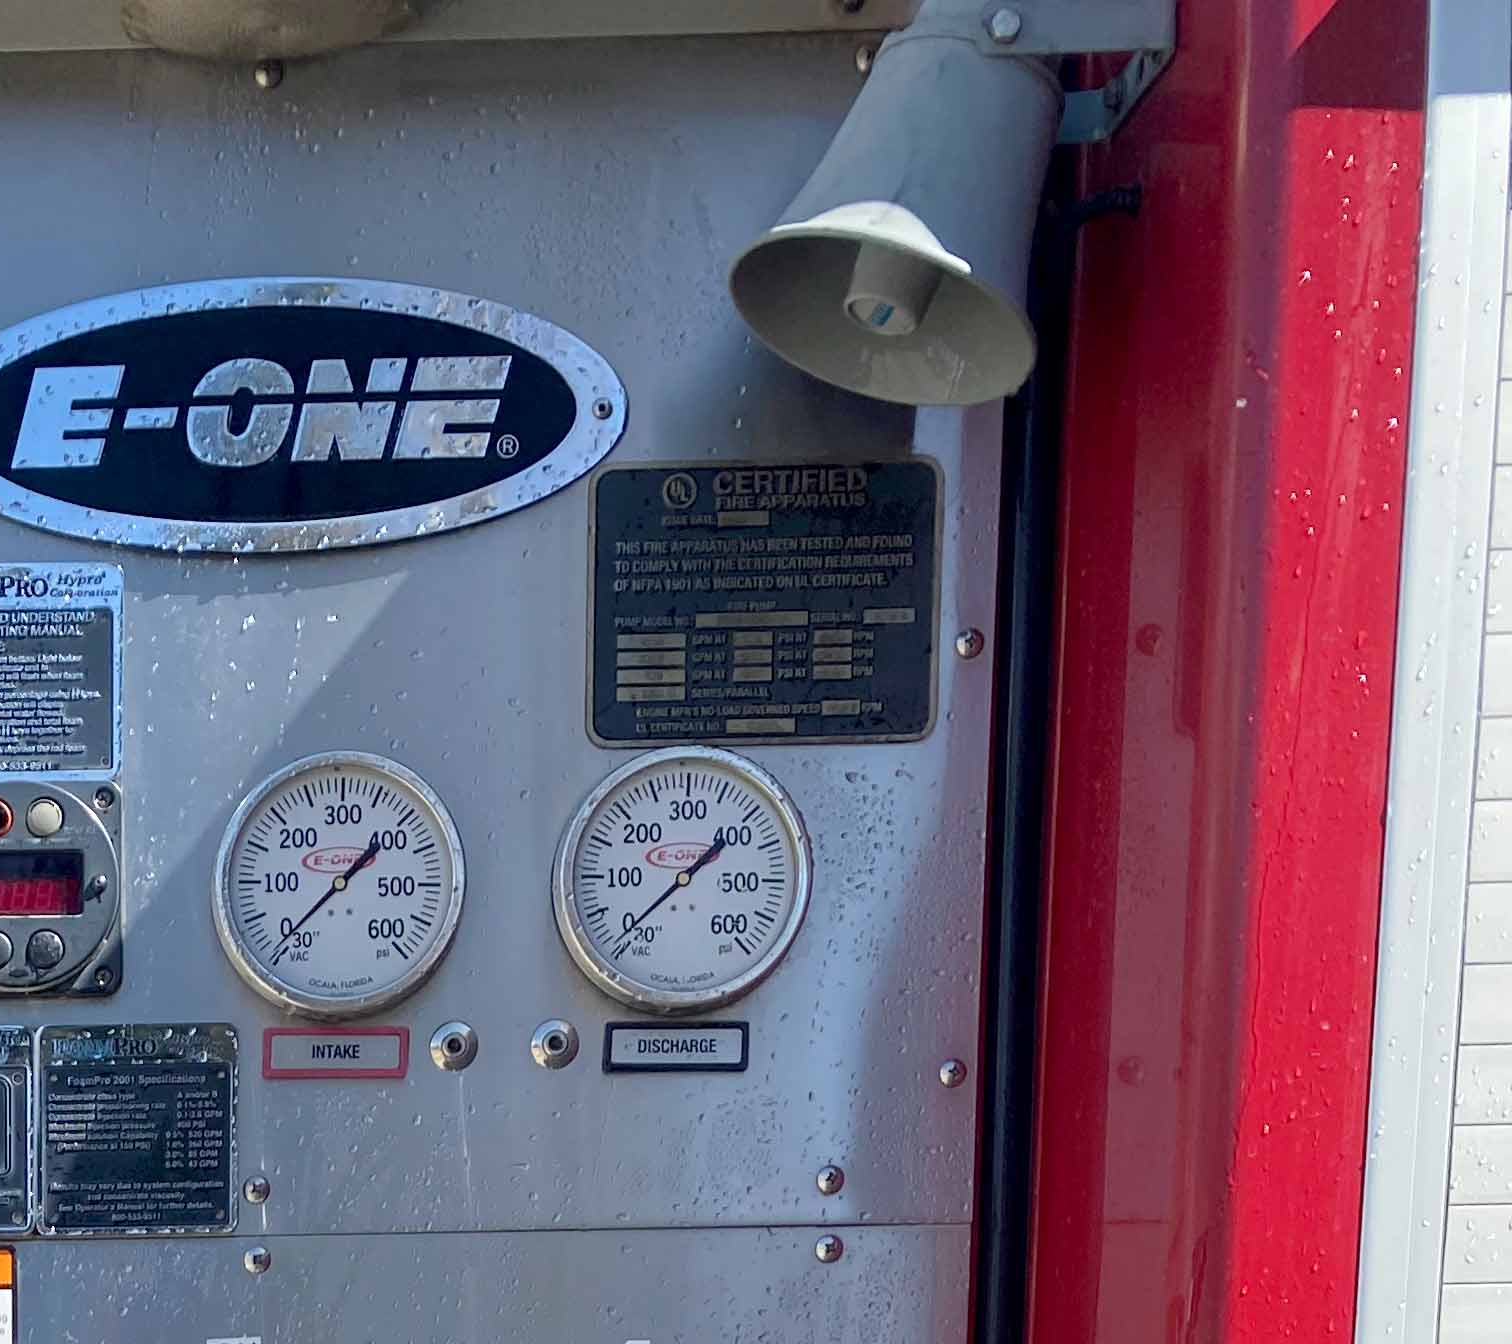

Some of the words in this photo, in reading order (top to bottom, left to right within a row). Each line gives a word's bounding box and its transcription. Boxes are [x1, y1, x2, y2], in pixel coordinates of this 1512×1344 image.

[713, 469, 867, 495] CERTIFIED
[716, 496, 754, 510] FIRE
[759, 493, 865, 509] APPARATUS
[12, 611, 95, 624] UNDERSTAND
[30, 625, 83, 637] MANUAL
[324, 804, 362, 825] 300
[279, 828, 317, 848] 200
[369, 830, 407, 850] 400
[264, 872, 299, 893] 100
[378, 876, 415, 897] 500
[368, 918, 405, 938] 600
[289, 950, 309, 962] VAC
[376, 949, 390, 959] psi
[311, 1042, 360, 1059] INTAKE
[637, 1038, 717, 1055] DISCHARGE
